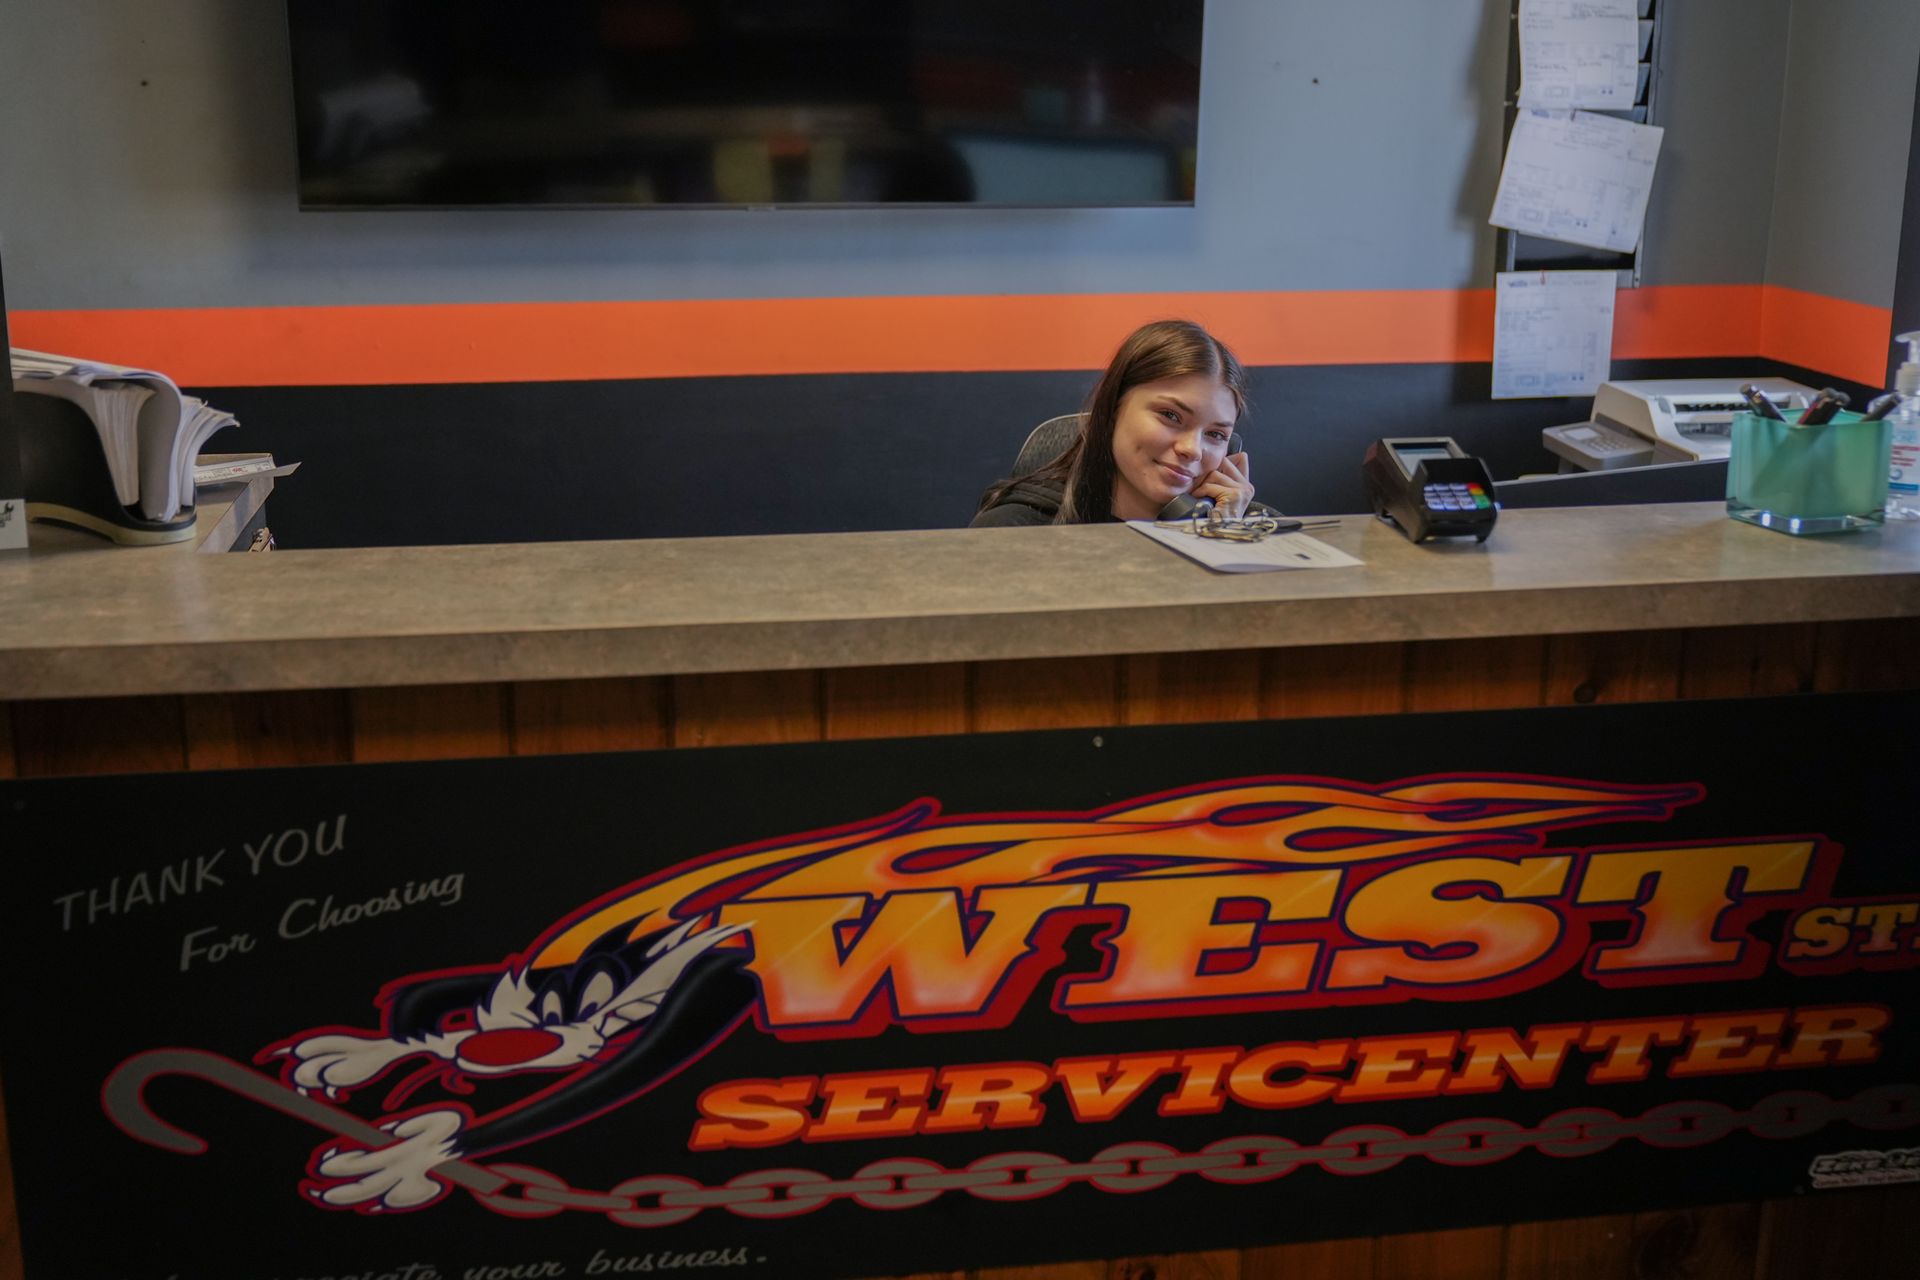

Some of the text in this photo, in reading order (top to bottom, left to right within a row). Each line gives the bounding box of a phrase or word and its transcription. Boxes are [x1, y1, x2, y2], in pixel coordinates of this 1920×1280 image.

[53, 814, 348, 932] THANK YOU
[179, 871, 466, 973] For Choosing
[715, 840, 1822, 1034] WEST
[689, 1004, 1891, 1150] SERVICENTER
[462, 1257, 567, 1280] your
